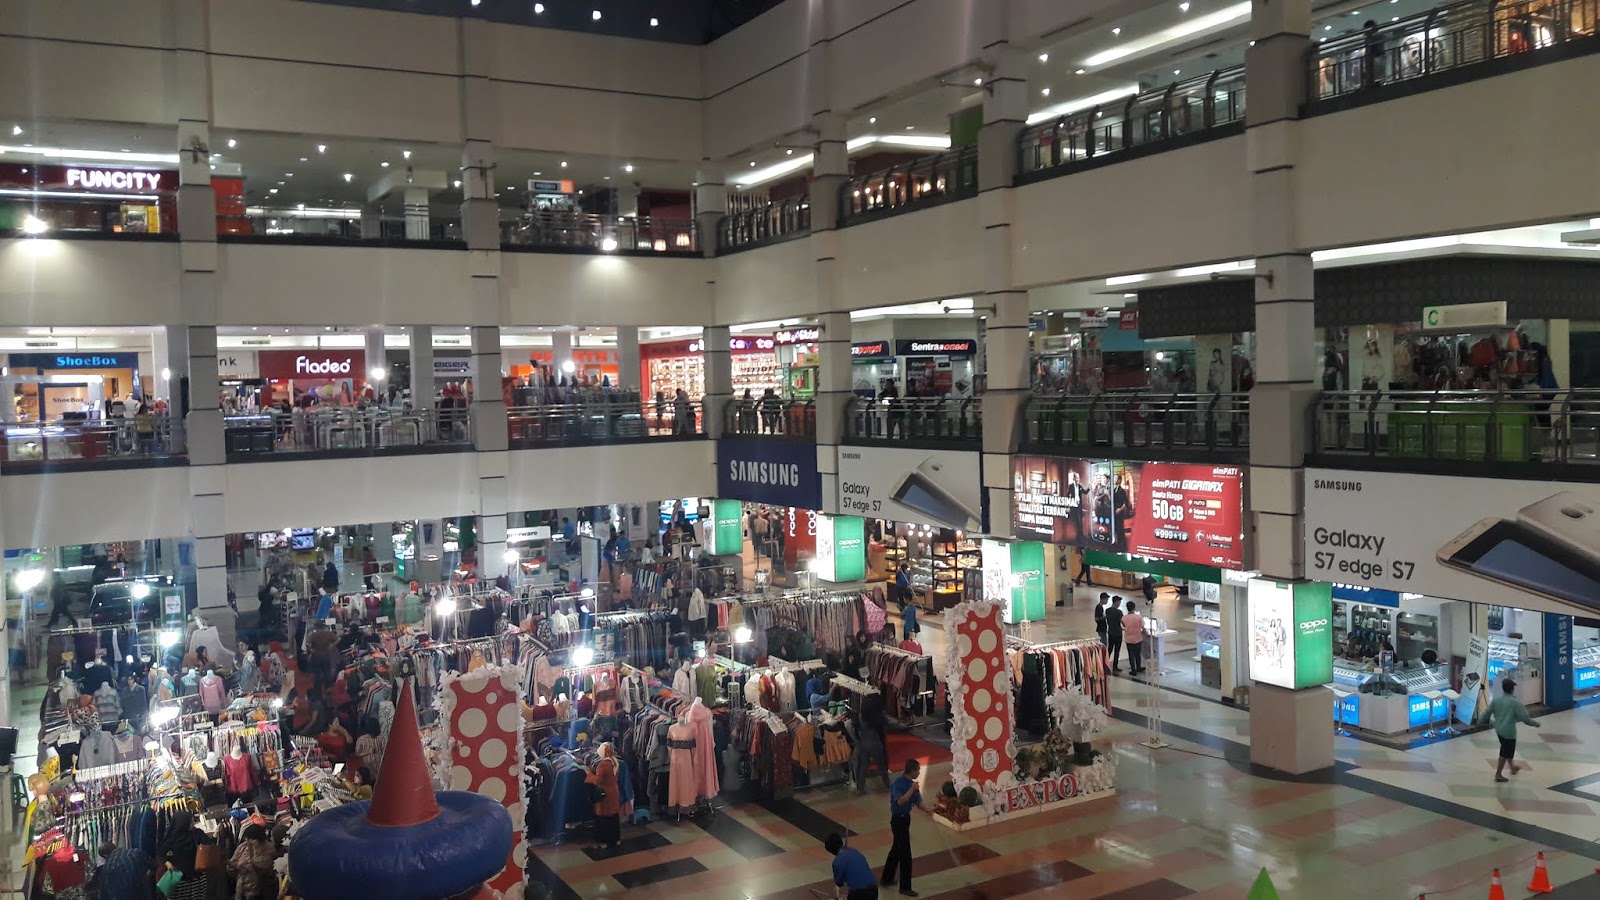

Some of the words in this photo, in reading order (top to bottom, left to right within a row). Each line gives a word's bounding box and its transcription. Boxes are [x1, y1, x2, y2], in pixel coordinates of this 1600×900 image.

[66, 169, 161, 190] FUNCITY
[1428, 310, 1439, 326] C
[56, 356, 118, 366] ShoeBox
[296, 356, 351, 373] Fladeo
[730, 459, 799, 487] SAMSUNG
[842, 482, 870, 498] Galaxy
[1313, 479, 1362, 492] SAMSUNG
[843, 496, 852, 508] S7
[852, 501, 870, 513] edge
[872, 500, 882, 512] S7
[1313, 527, 1385, 556] Galaxy
[1314, 552, 1335, 570] S7
[1339, 559, 1383, 580] edge
[1392, 561, 1416, 580] S7
[1299, 619, 1328, 629] oppo
[1411, 700, 1443, 712] SAMSNG
[1004, 773, 1078, 812] EXPO
